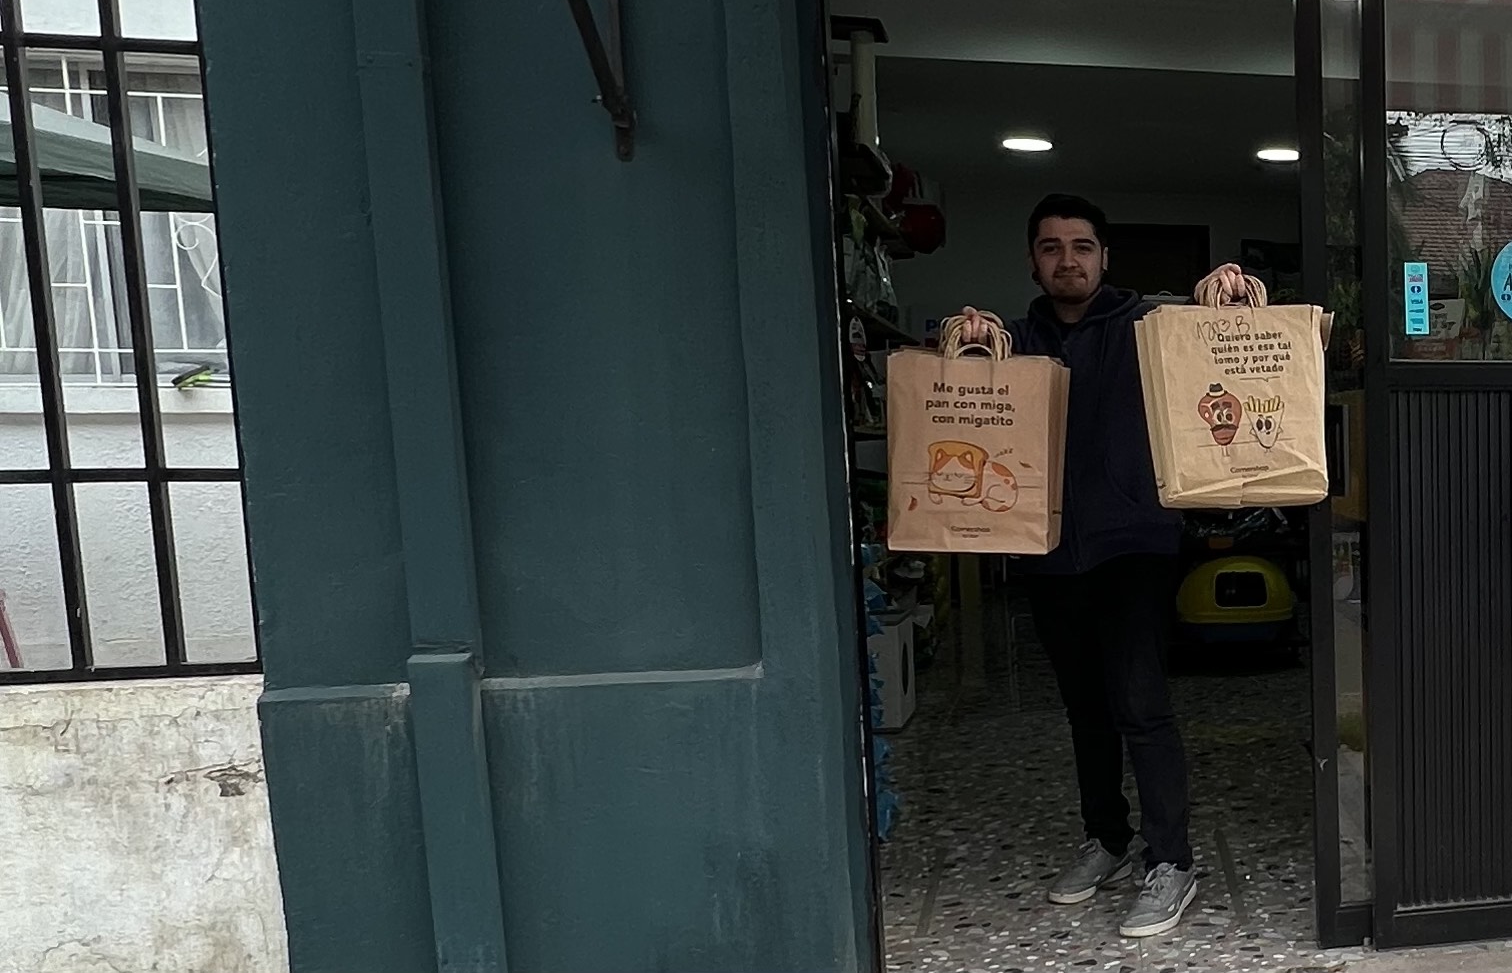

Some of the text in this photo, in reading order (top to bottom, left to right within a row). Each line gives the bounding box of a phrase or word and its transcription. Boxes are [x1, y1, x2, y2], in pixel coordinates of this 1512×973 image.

[1217, 331, 1283, 342] Quiero saber
[1243, 344, 1254, 352] es
[1257, 343, 1275, 351] ese
[1277, 341, 1292, 350] tal
[1242, 355, 1249, 365] y
[1252, 355, 1269, 364] por
[1224, 363, 1284, 375] está vetado
[933, 382, 1010, 397] Me gusta el
[925, 399, 1016, 414] pan con miga,
[932, 414, 1014, 428] con migatito
